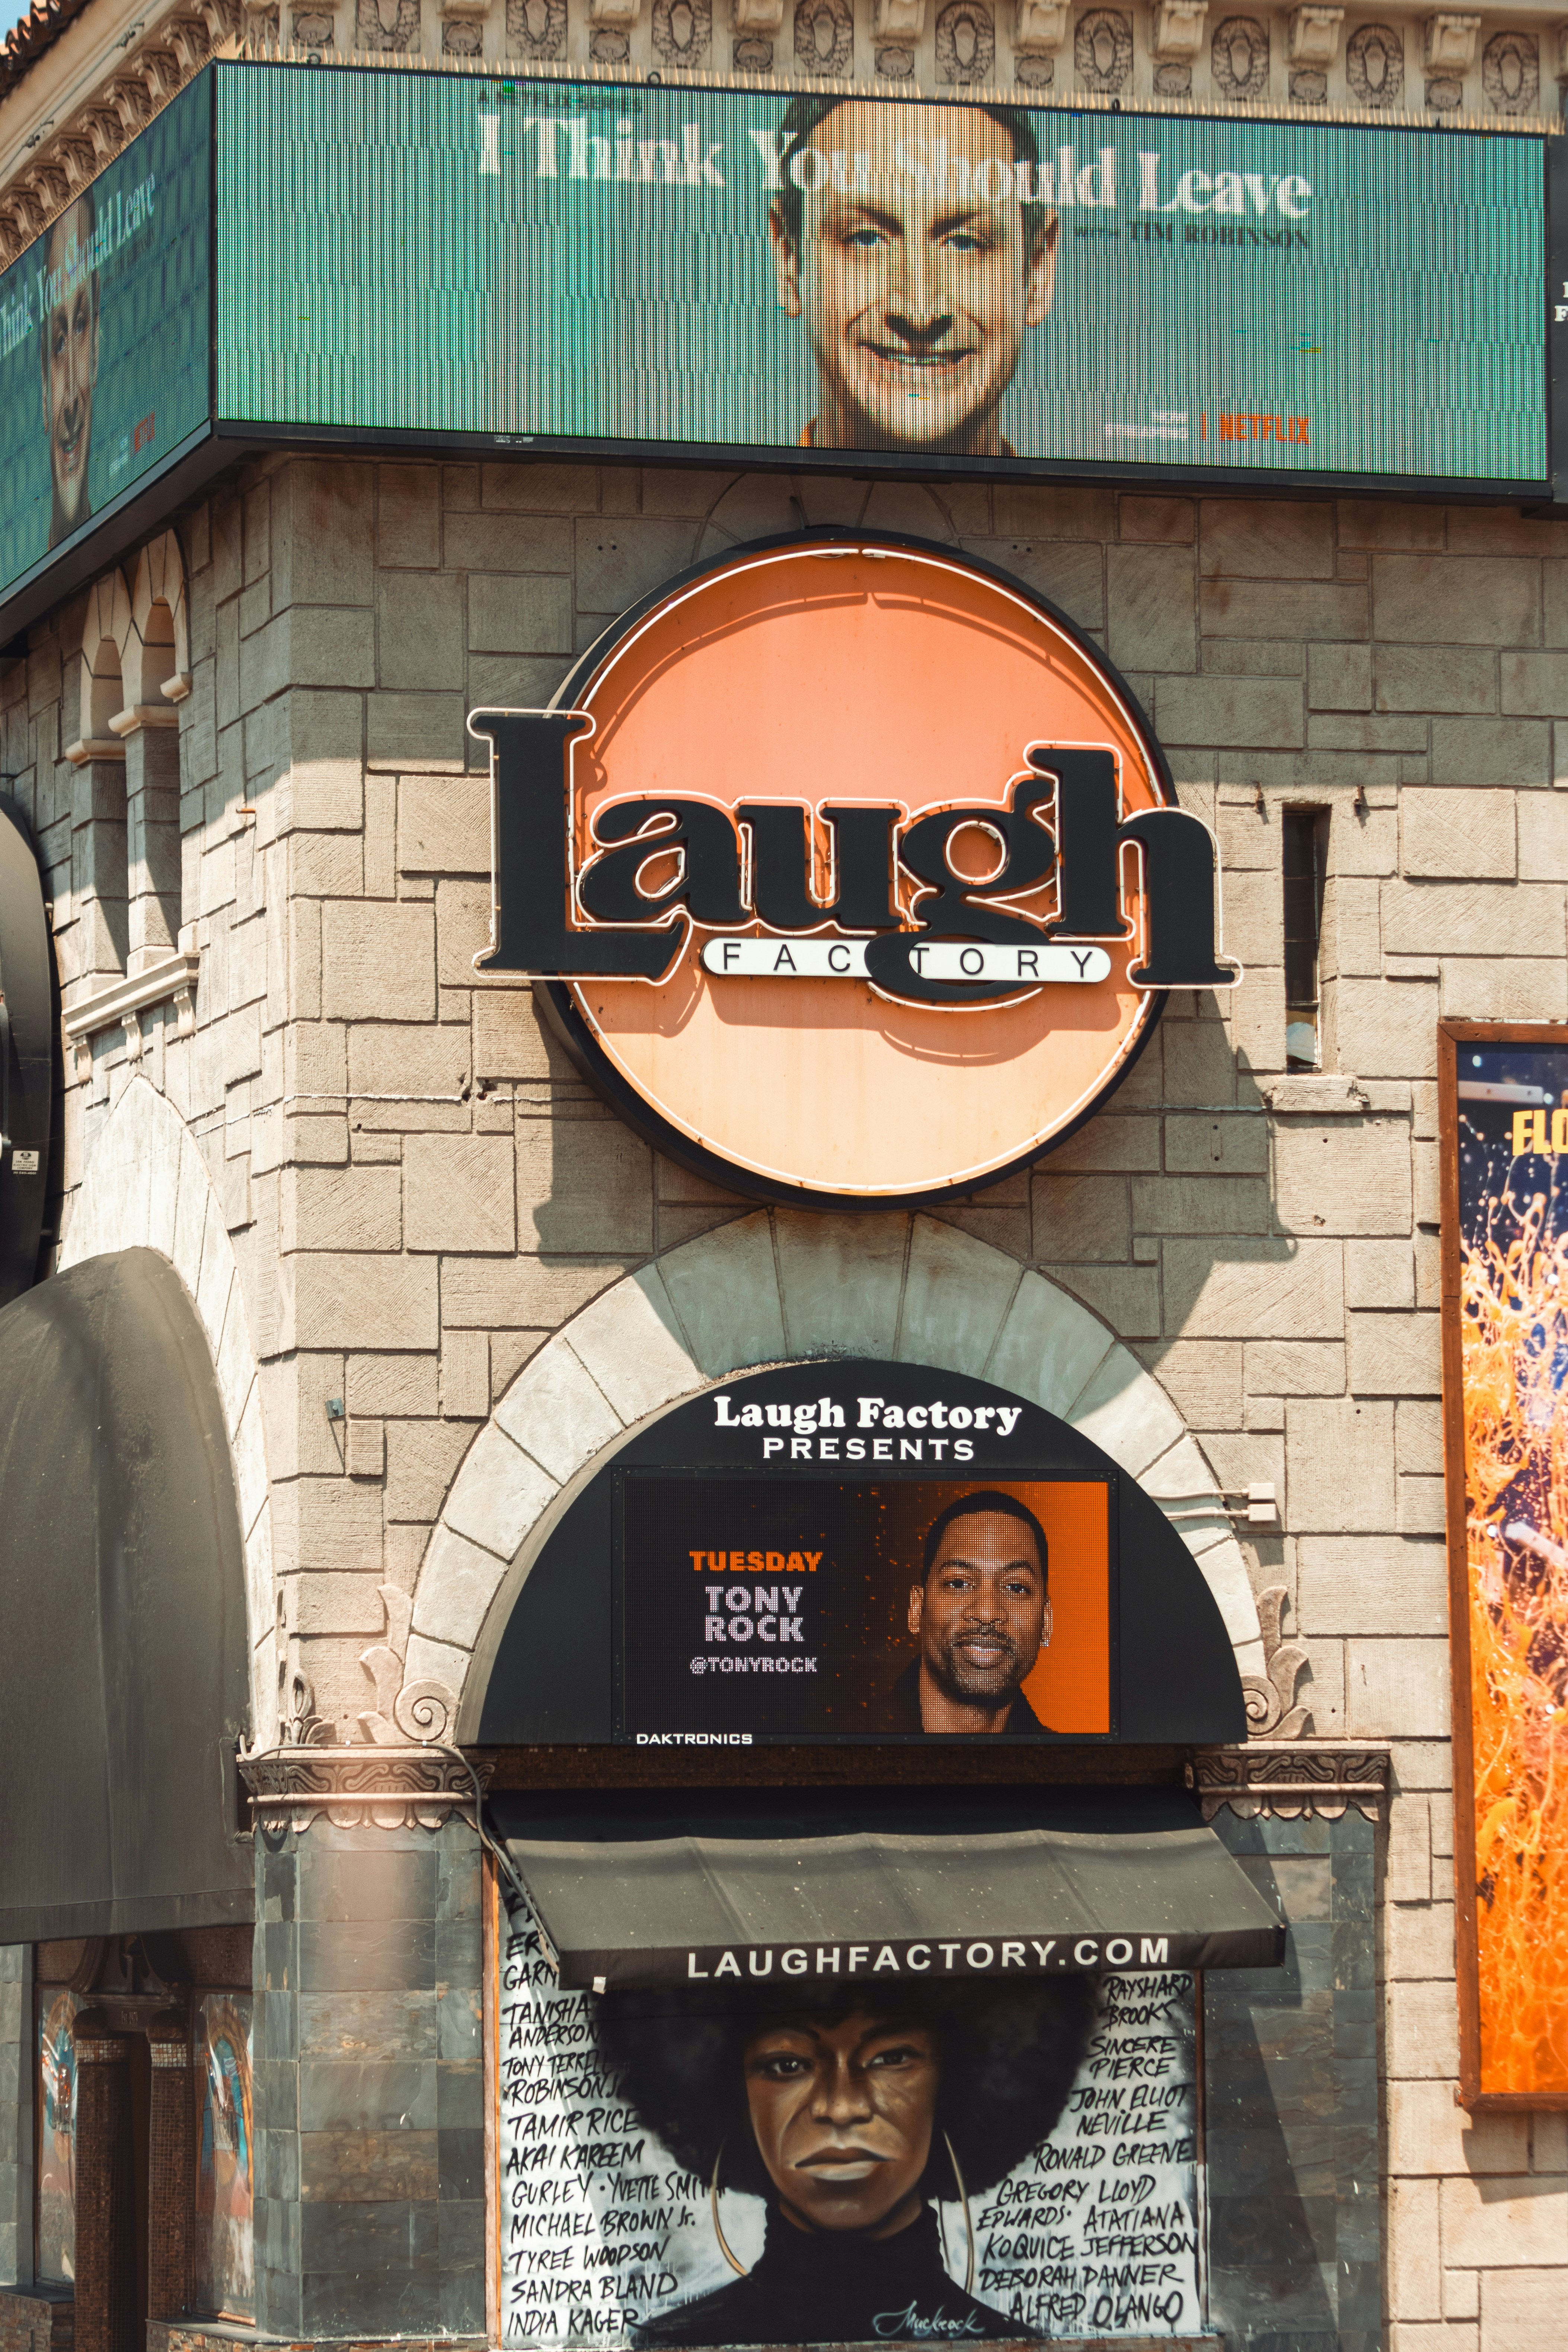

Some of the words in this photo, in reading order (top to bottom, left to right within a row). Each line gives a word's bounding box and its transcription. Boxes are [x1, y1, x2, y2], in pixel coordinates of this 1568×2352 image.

[478, 115, 501, 174] I
[524, 118, 725, 187] Think
[747, 129, 872, 193] You
[891, 137, 1117, 207] Should
[1137, 151, 1312, 218] Leave
[116, 172, 156, 248] Leave
[1127, 221, 1173, 242] TIM
[1185, 224, 1310, 249] ROBINSON
[1219, 413, 1310, 445] NETFLIX
[468, 708, 1243, 1007] Laugh
[723, 943, 1095, 978] FACTORY
[713, 1396, 846, 1435] Laugh
[857, 1397, 1022, 1436] Factory
[763, 1437, 974, 1461] PRESENTS
[689, 1551, 823, 1571] TUESDAY
[705, 1586, 803, 1613] TONY
[705, 1615, 805, 1641] ROCK
[690, 1657, 818, 1675] @TONYROCK
[636, 1733, 753, 1745] DAKTRONICS
[687, 1938, 1169, 1978] LAUGHFACTORY.COM
[1103, 1973, 1192, 2005] RAYSHARD
[502, 1994, 593, 2031] TANISHA
[1098, 1999, 1177, 2031] BROOKS
[508, 2021, 600, 2049] ANDERSON
[1086, 2035, 1184, 2058] SINCERE
[502, 2055, 545, 2079] TONY
[547, 2049, 614, 2078] TERRELL
[1089, 2056, 1176, 2080] PIERCE
[507, 2073, 607, 2107] ROBINSON
[1070, 2087, 1126, 2113] JOHN
[1129, 2083, 1195, 2111] ELLIOT
[506, 2110, 584, 2141] TAMIR
[585, 2108, 639, 2136] RICE
[505, 2143, 557, 2177] AKAI
[559, 2139, 645, 2170] KAREEM
[1034, 2143, 1105, 2174] RONALD
[1112, 2137, 1193, 2167] GREENE
[511, 2171, 594, 2209] GURLEY
[607, 2172, 660, 2203] YVETTE
[996, 2179, 1089, 2206] GREGORY
[1098, 2174, 1156, 2205] LLOYD
[510, 2212, 595, 2243] MICHAEL
[600, 2206, 674, 2237] BROWN
[677, 2205, 696, 2228] Jr.
[1083, 2201, 1185, 2235] ATATIANA
[508, 2245, 575, 2274] TYREE
[583, 2235, 671, 2268] WOODSON
[983, 2232, 1075, 2264] KOQUICE
[1080, 2233, 1198, 2258] JEFFERSON
[510, 2278, 592, 2304] SANDRA
[598, 2272, 678, 2300] BLAND
[979, 2265, 1076, 2291] DEBORAH
[1082, 2263, 1185, 2286] DANNER
[507, 2308, 558, 2336] INDIA
[567, 2307, 651, 2336] KAGER
[1010, 2292, 1087, 2323] ALFRED
[1093, 2291, 1184, 2330] OLANGO
